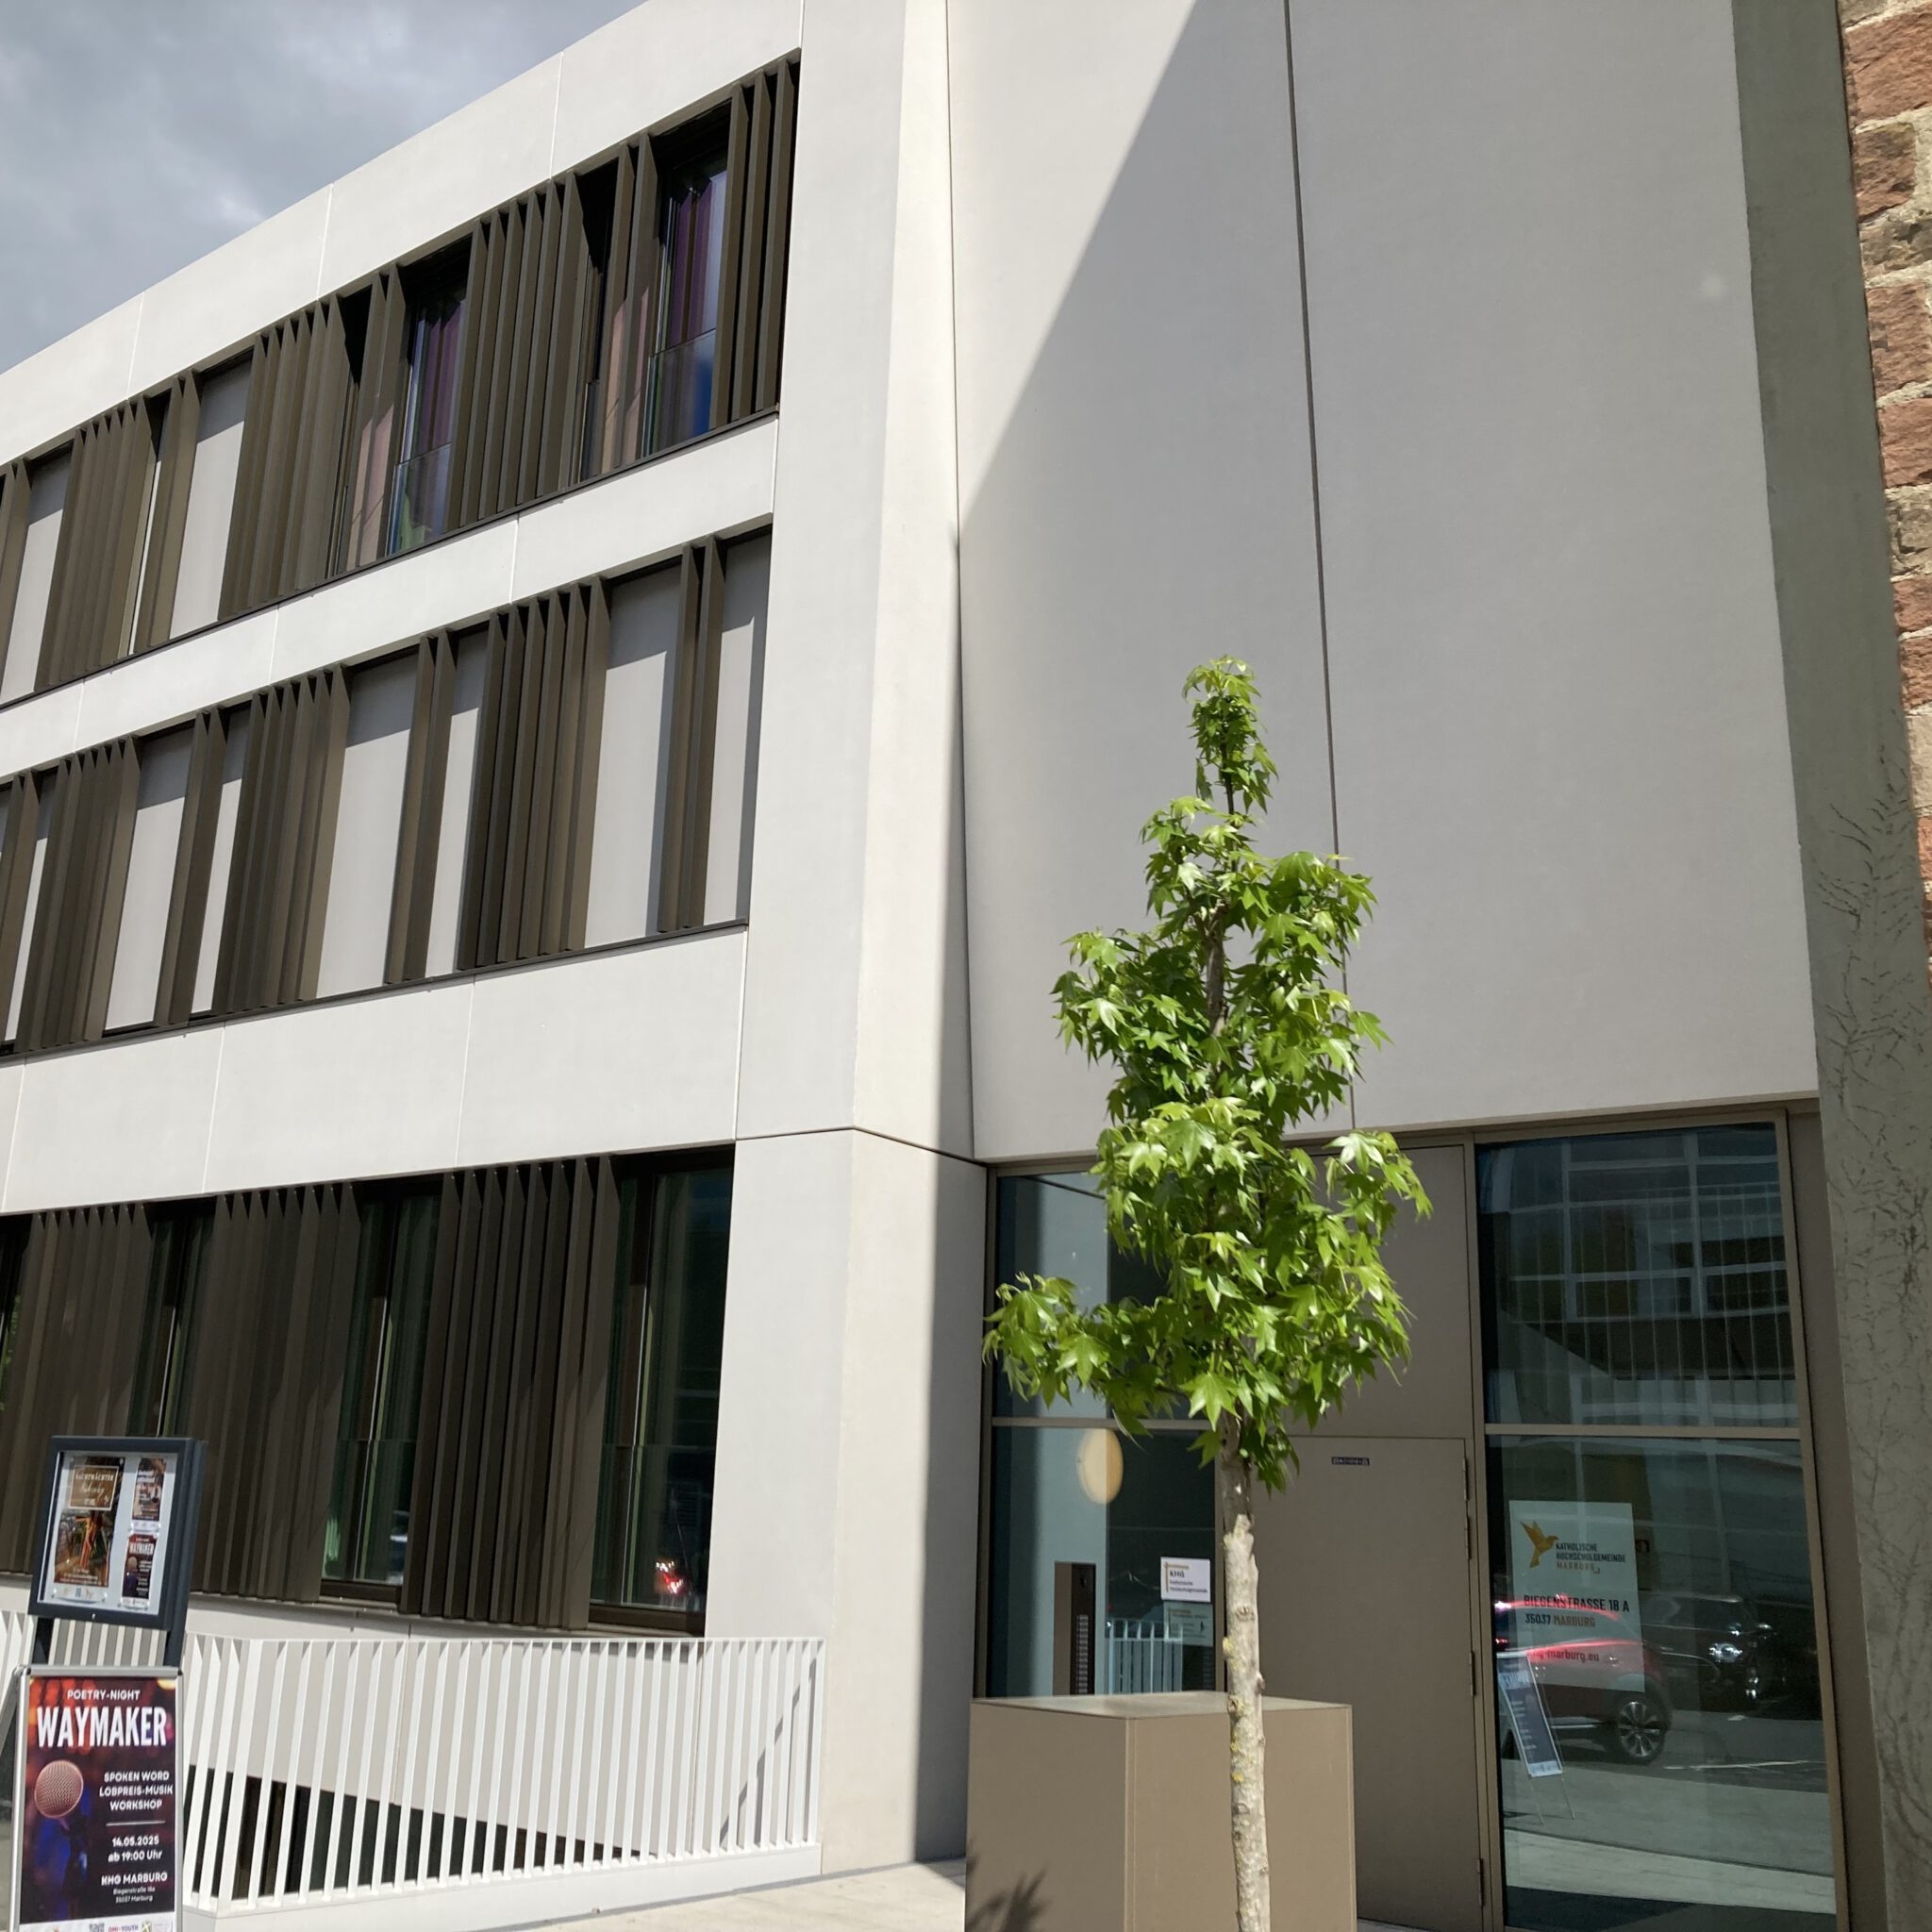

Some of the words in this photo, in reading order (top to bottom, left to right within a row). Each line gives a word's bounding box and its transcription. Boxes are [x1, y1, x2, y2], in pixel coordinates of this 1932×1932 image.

[1556, 1542, 1598, 1552] KATHOLISCHE
[1556, 1552, 1626, 1563] HOCHSCHULGEMEINDE
[1557, 1561, 1595, 1571] MARBURG
[1524, 1594, 1607, 1611] BIEGENSTRASSE
[1609, 1599, 1620, 1612] 18
[1623, 1601, 1630, 1612] A
[1524, 1613, 1552, 1625] 35037
[1554, 1615, 1596, 1627] MARBURG
[67, 1689, 141, 1701] POETRY-NIGHT
[36, 1706, 168, 1748] WAYMAKER
[104, 1771, 140, 1783] SPOKEN
[142, 1770, 170, 1781] WORD
[99, 1784, 174, 1797] LOBPREIS-MUSIK
[109, 1798, 163, 1810] WORKSHOP
[111, 1834, 159, 1848] 14.05.2025
[108, 1852, 120, 1862] ab
[122, 1850, 145, 1862] 19:00
[146, 1850, 162, 1860] Uhr
[101, 1874, 122, 1886] KHG
[123, 1871, 168, 1885] MARBURG
[131, 1894, 154, 1903] Marburg
